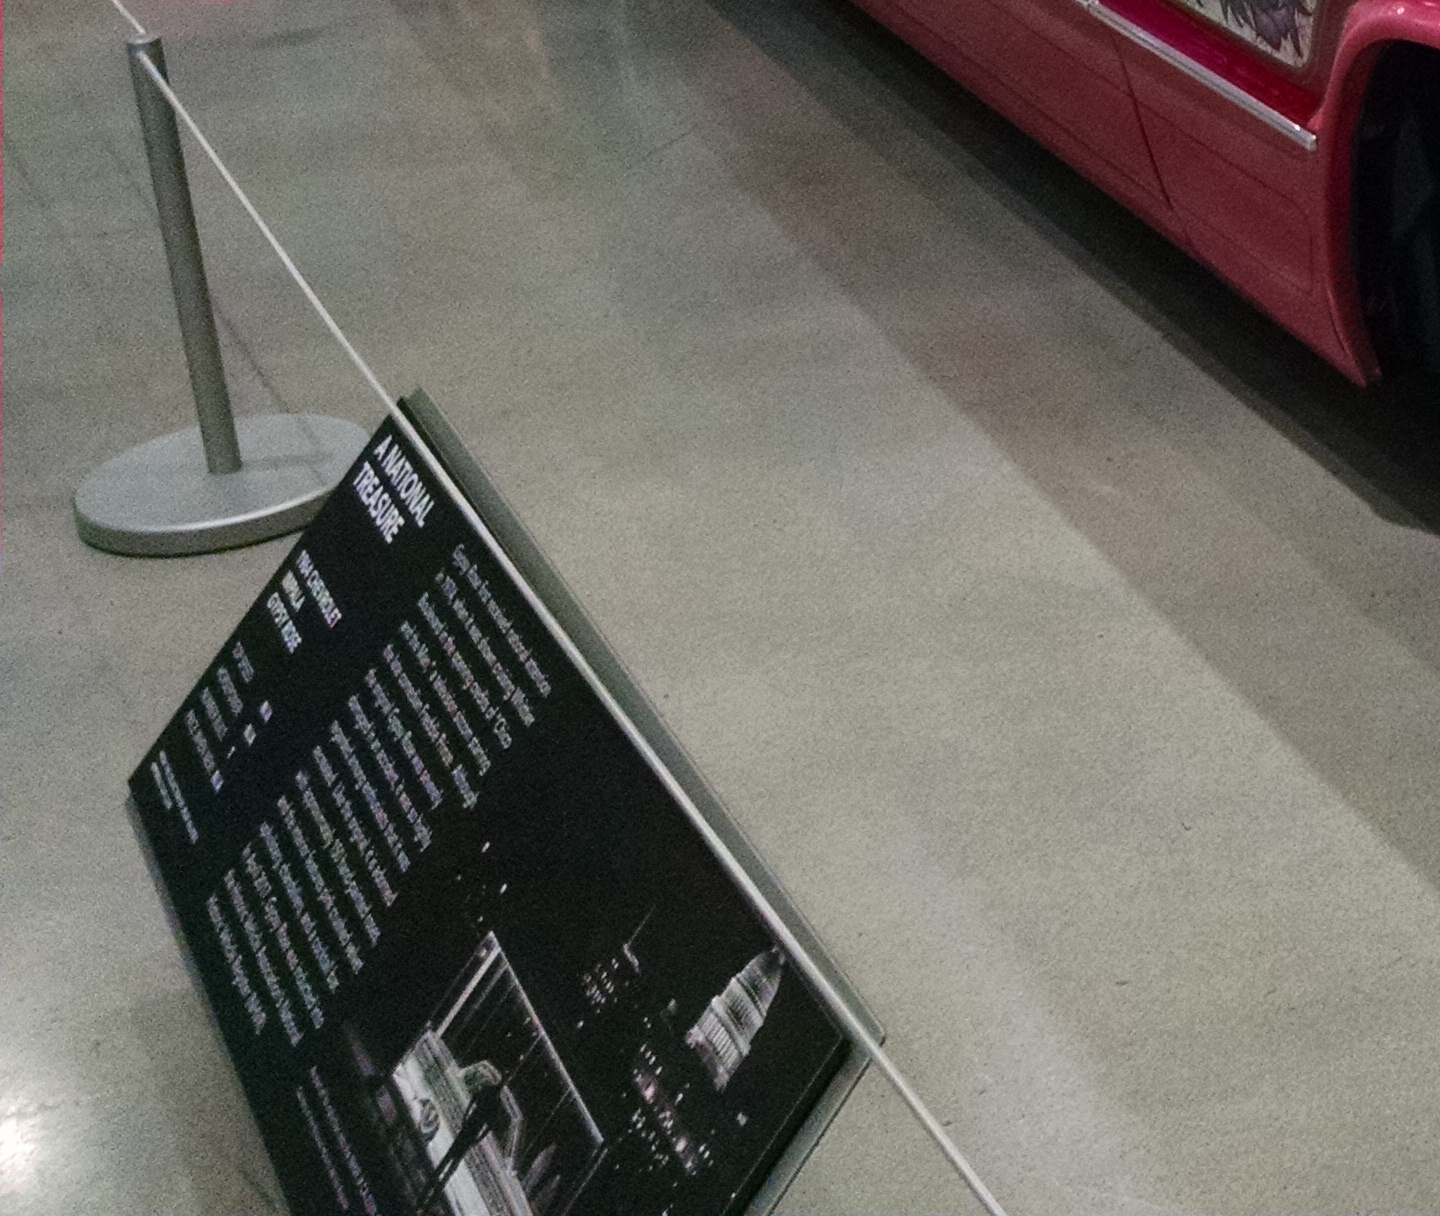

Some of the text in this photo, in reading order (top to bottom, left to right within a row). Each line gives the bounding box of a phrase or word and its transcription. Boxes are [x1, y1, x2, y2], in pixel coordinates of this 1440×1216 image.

[353, 461, 404, 543] TREASURE
[374, 435, 434, 527] A NATIONAL
[307, 570, 342, 627] CHEVROLET
